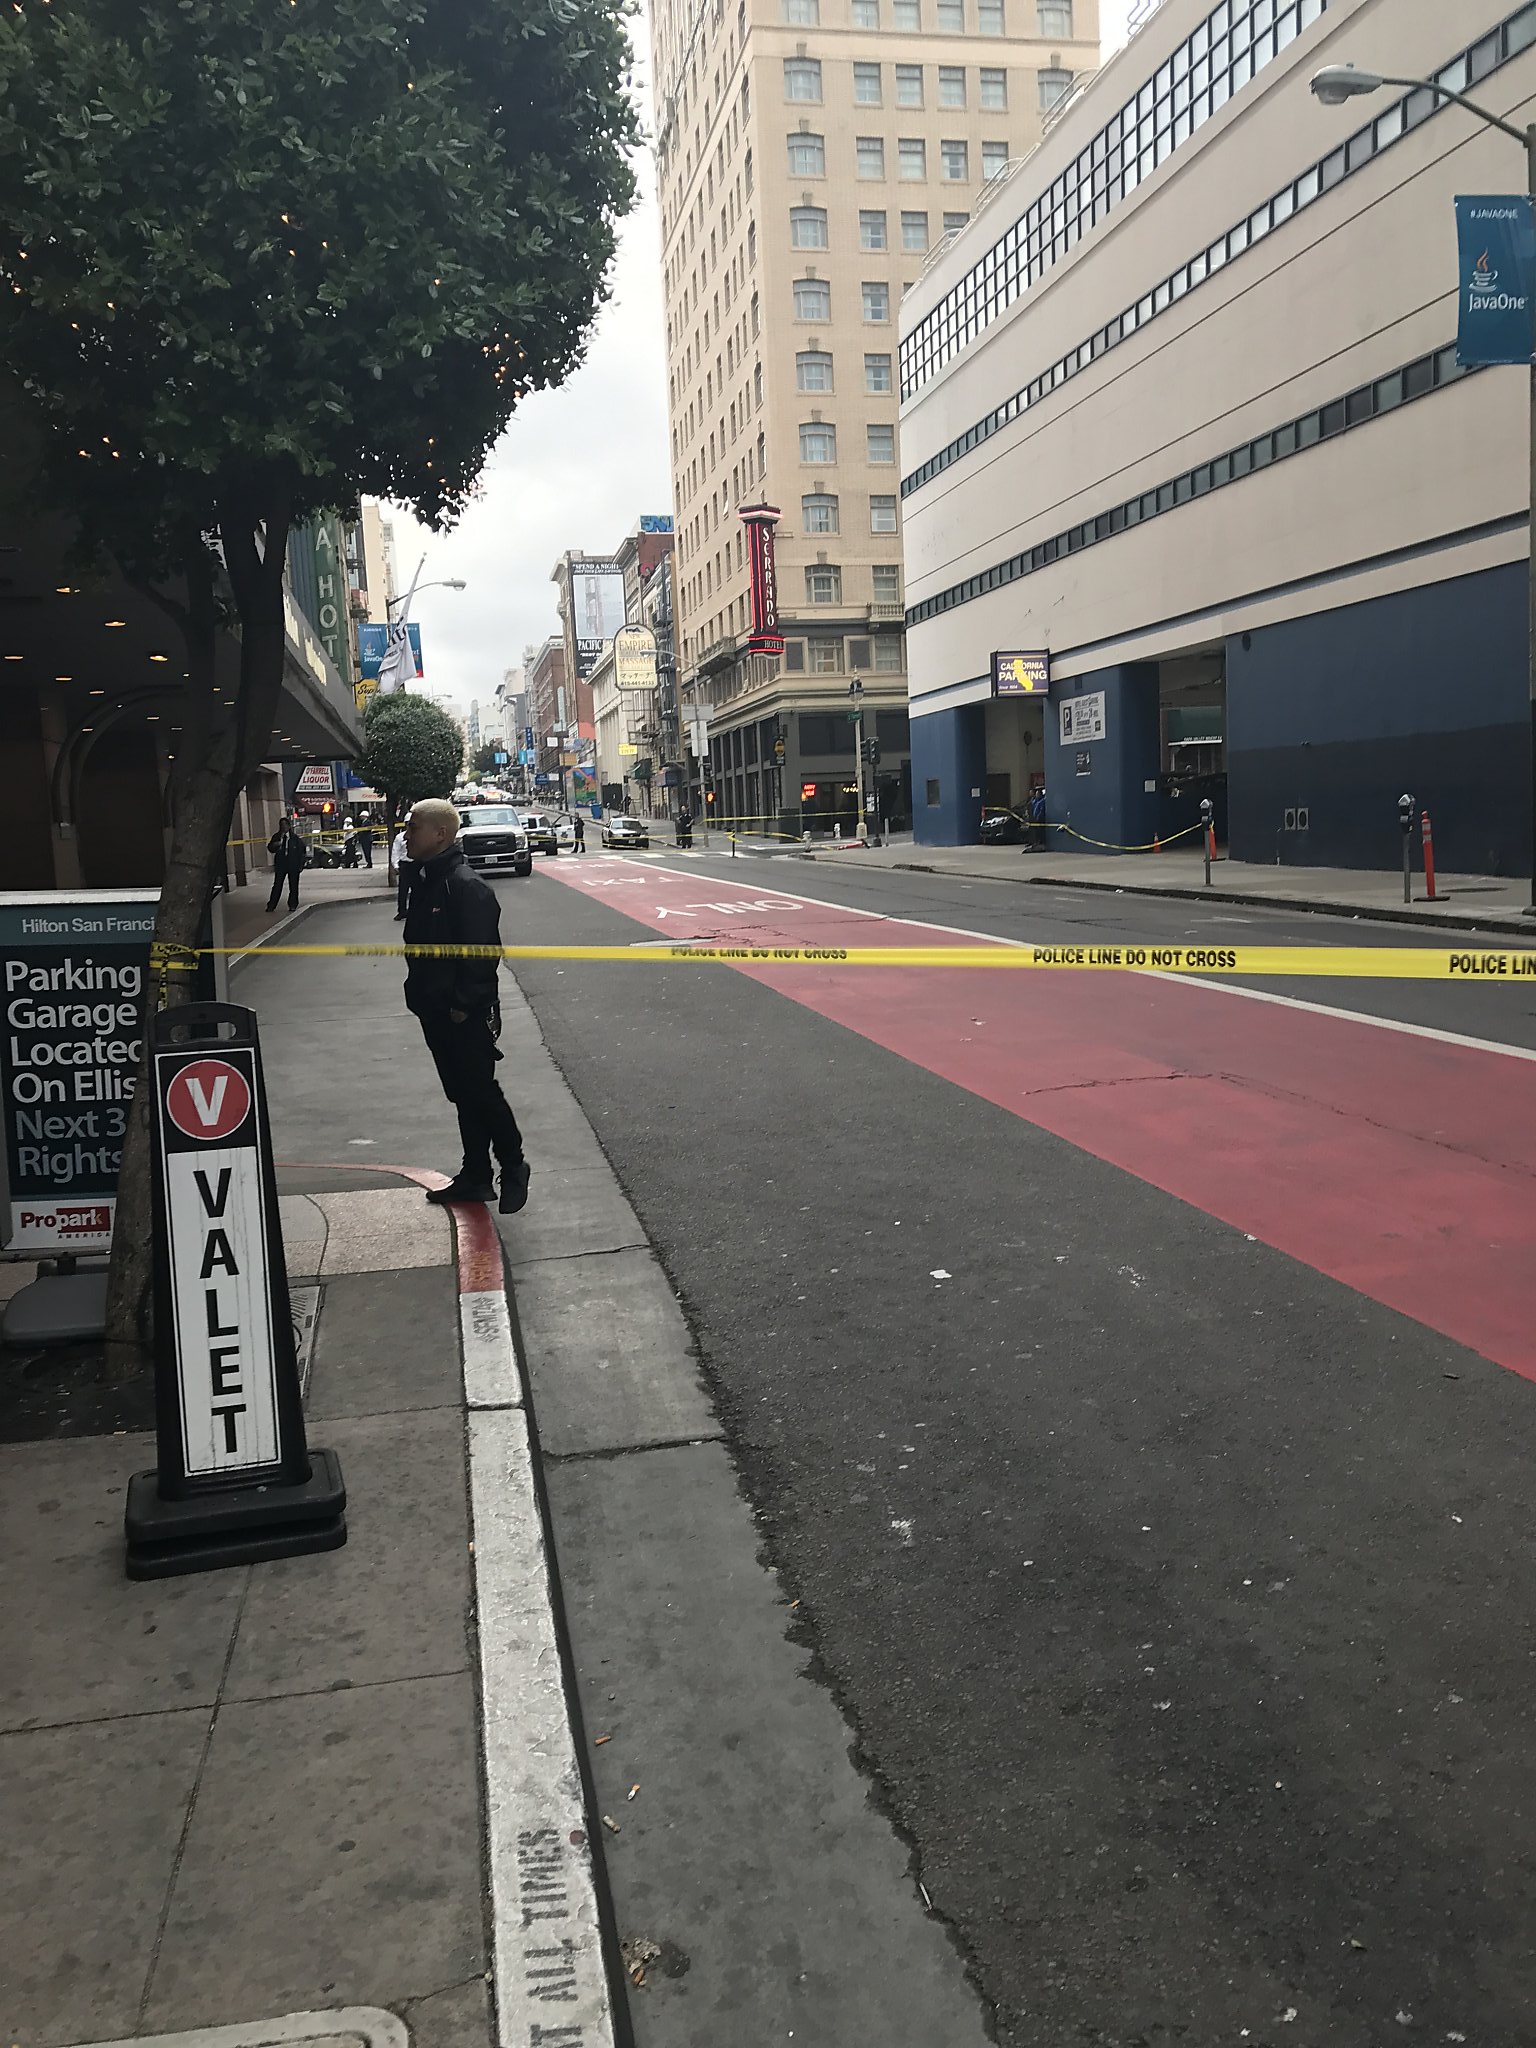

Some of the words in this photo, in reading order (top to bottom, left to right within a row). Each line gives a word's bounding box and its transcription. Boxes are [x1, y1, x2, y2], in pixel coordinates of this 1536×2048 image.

[1470, 208, 1518, 219] #JAVAONE
[1469, 293, 1525, 312] JavaOne
[762, 527, 775, 627] SERRANO
[318, 574, 339, 669] HOT
[577, 640, 602, 651] PACIFIC
[619, 639, 653, 651] EMPIRE
[764, 640, 784, 650] HOTEL
[364, 655, 383, 663] JavaOn
[619, 656, 654, 665] MASSAGE
[1000, 661, 1044, 671] CALORNIA
[302, 776, 329, 784] LIQUOR
[305, 767, 329, 775] O'FARRELL
[655, 899, 804, 919] ONLY
[22, 918, 68, 933] Hilton
[72, 918, 103, 932] San
[106, 917, 155, 931] Franci
[671, 947, 716, 957] POLICE
[719, 948, 748, 958] LINE
[752, 948, 769, 958] DO
[773, 948, 799, 959] NOT
[804, 949, 847, 960] CROSS
[1033, 948, 1085, 964] POLICE
[1089, 948, 1122, 964] LINE
[1126, 949, 1146, 965] DO
[1151, 949, 1182, 967] NOT
[1186, 950, 1236, 968] CROSS
[1449, 954, 1507, 974] POLICE
[1512, 955, 1536, 975] LIN
[5, 958, 141, 997] Parking
[7, 998, 137, 1035] Garage
[12, 1072, 67, 1104] On
[74, 1068, 137, 1101] Ellis
[184, 1075, 229, 1127] V
[16, 1109, 100, 1140] Next
[105, 1107, 127, 1137] 3
[18, 1143, 122, 1184] Rights
[21, 1208, 103, 1232] Propark
[192, 1167, 248, 1454] VALET
[517, 1829, 570, 1931] TIMES
[523, 1939, 580, 2001] ALL
